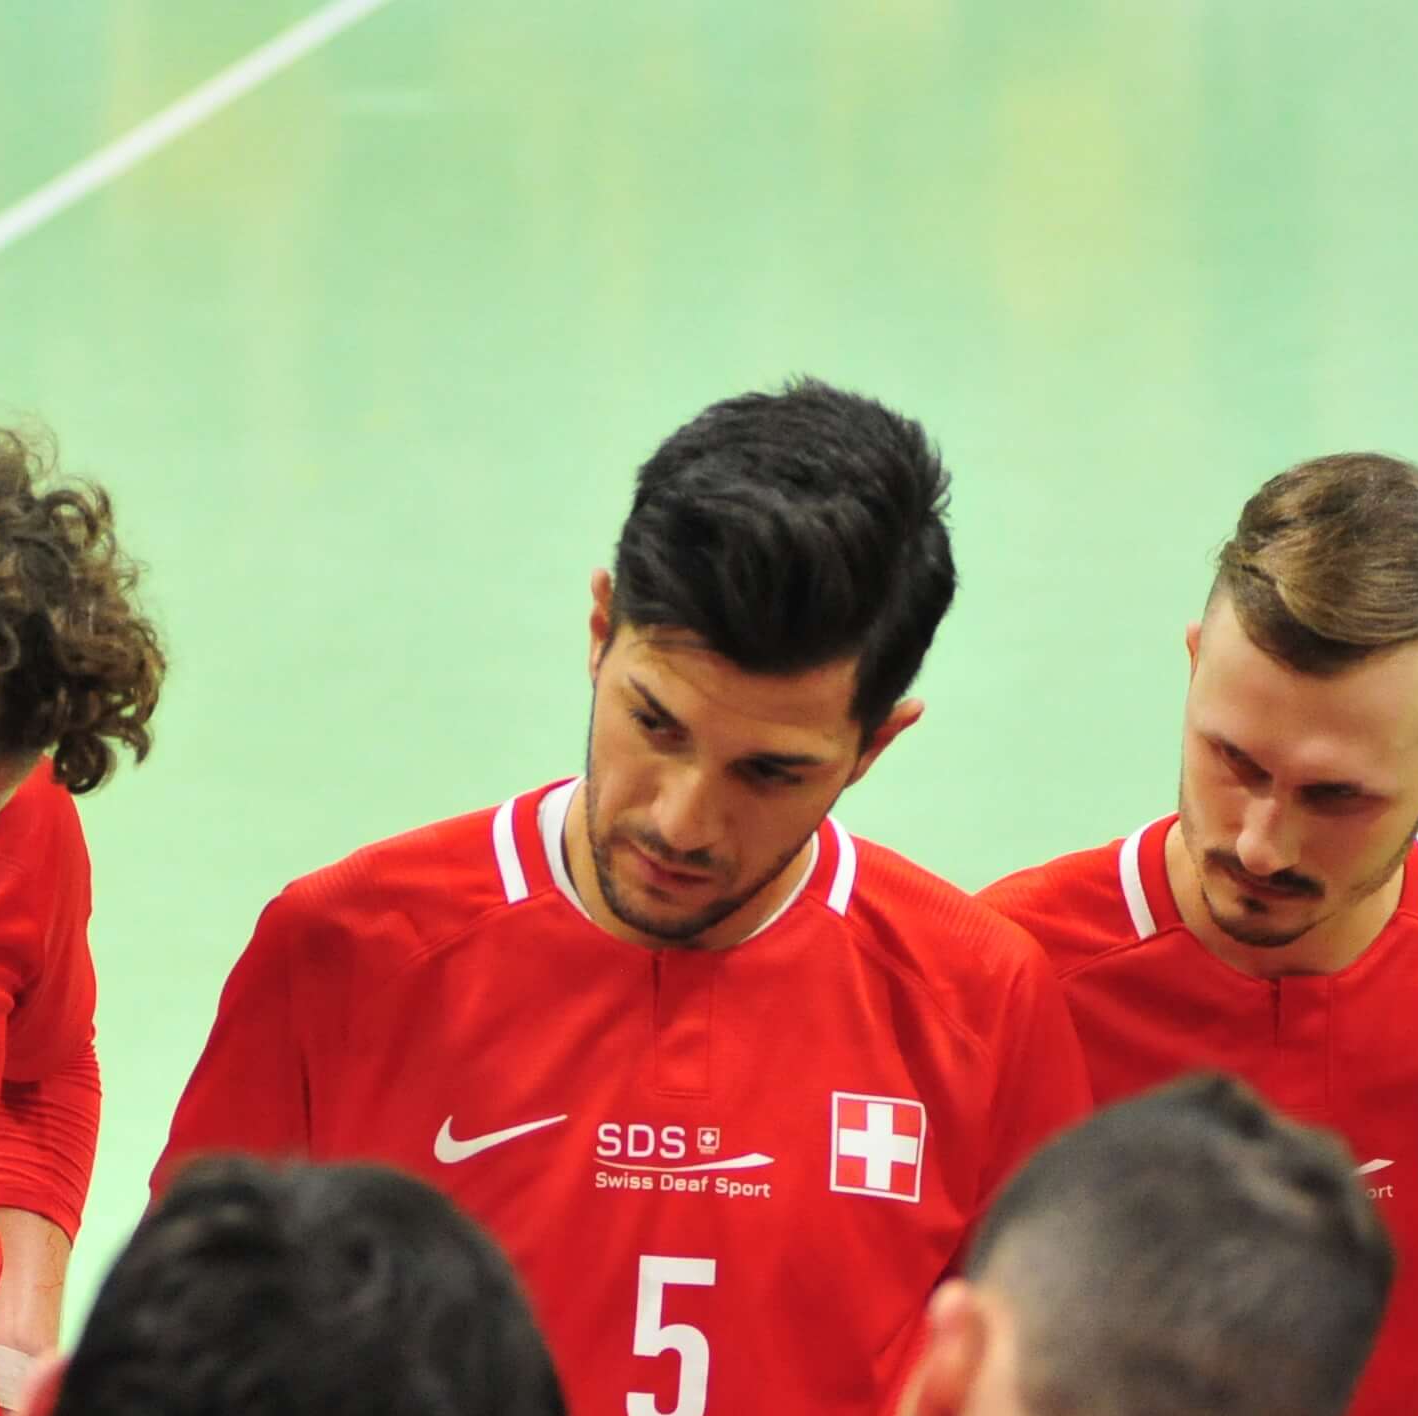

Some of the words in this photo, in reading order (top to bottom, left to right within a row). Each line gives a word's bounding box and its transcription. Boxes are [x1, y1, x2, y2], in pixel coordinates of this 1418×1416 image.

[596, 1122, 686, 1160] SDS
[595, 1171, 654, 1190] Swiss
[660, 1174, 709, 1193] Deaf
[715, 1176, 771, 1199] Sport
